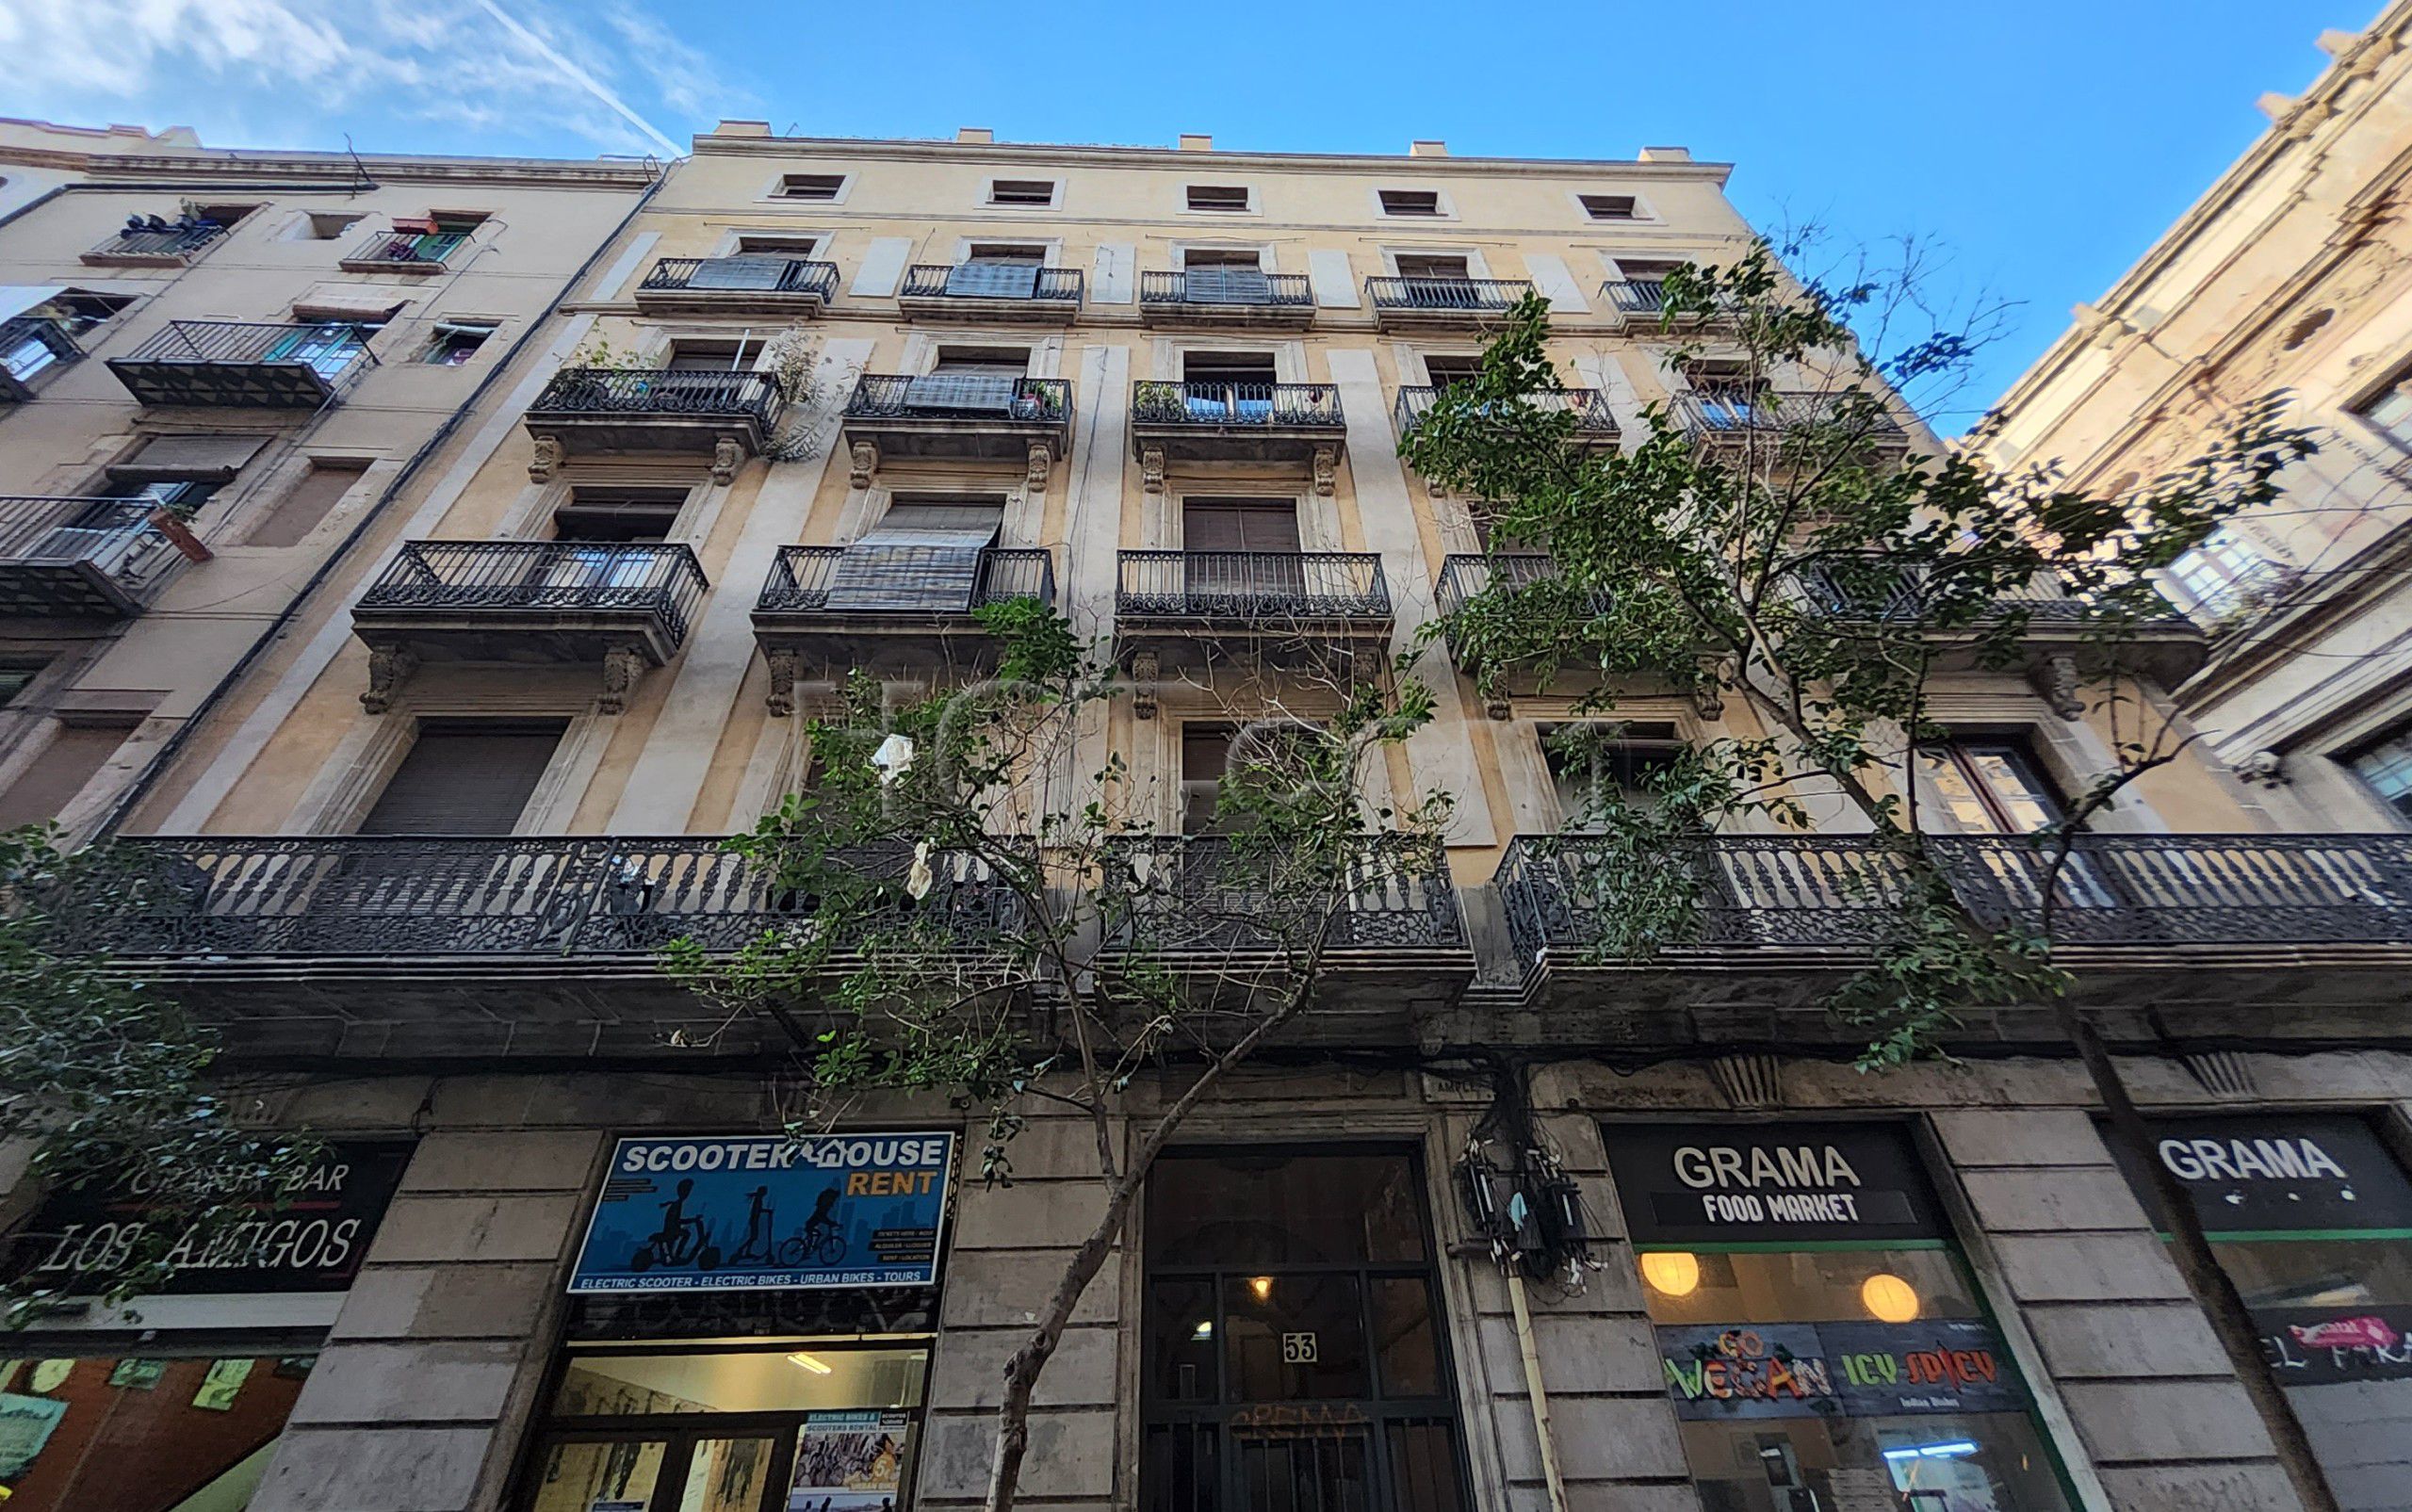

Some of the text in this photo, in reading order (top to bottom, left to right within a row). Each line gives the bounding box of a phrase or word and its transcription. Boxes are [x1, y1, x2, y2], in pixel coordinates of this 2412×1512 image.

[623, 1143, 793, 1172] SCOOTER
[1673, 1145, 1862, 1189] GRAMA
[2159, 1138, 2348, 1179] GRAMA
[284, 1163, 350, 1192] BAR
[848, 1171, 938, 1196] RENT
[1702, 1194, 1859, 1222] FOOD MARKET
[38, 1218, 362, 1271] LOS AMIGOS
[580, 1278, 636, 1290] ELECTRIC
[638, 1276, 693, 1288] SCOOTER
[700, 1276, 756, 1287] ELECTRIC
[757, 1275, 792, 1286] BIKES
[800, 1273, 840, 1284] URBAN
[841, 1273, 875, 1283] BIKES
[884, 1271, 921, 1282] TOURS
[1285, 1334, 1315, 1360] 53
[1719, 1330, 1764, 1358] GO
[1665, 1357, 1833, 1401] VEGAN
[1840, 1343, 1996, 1391] ICY SPICY
